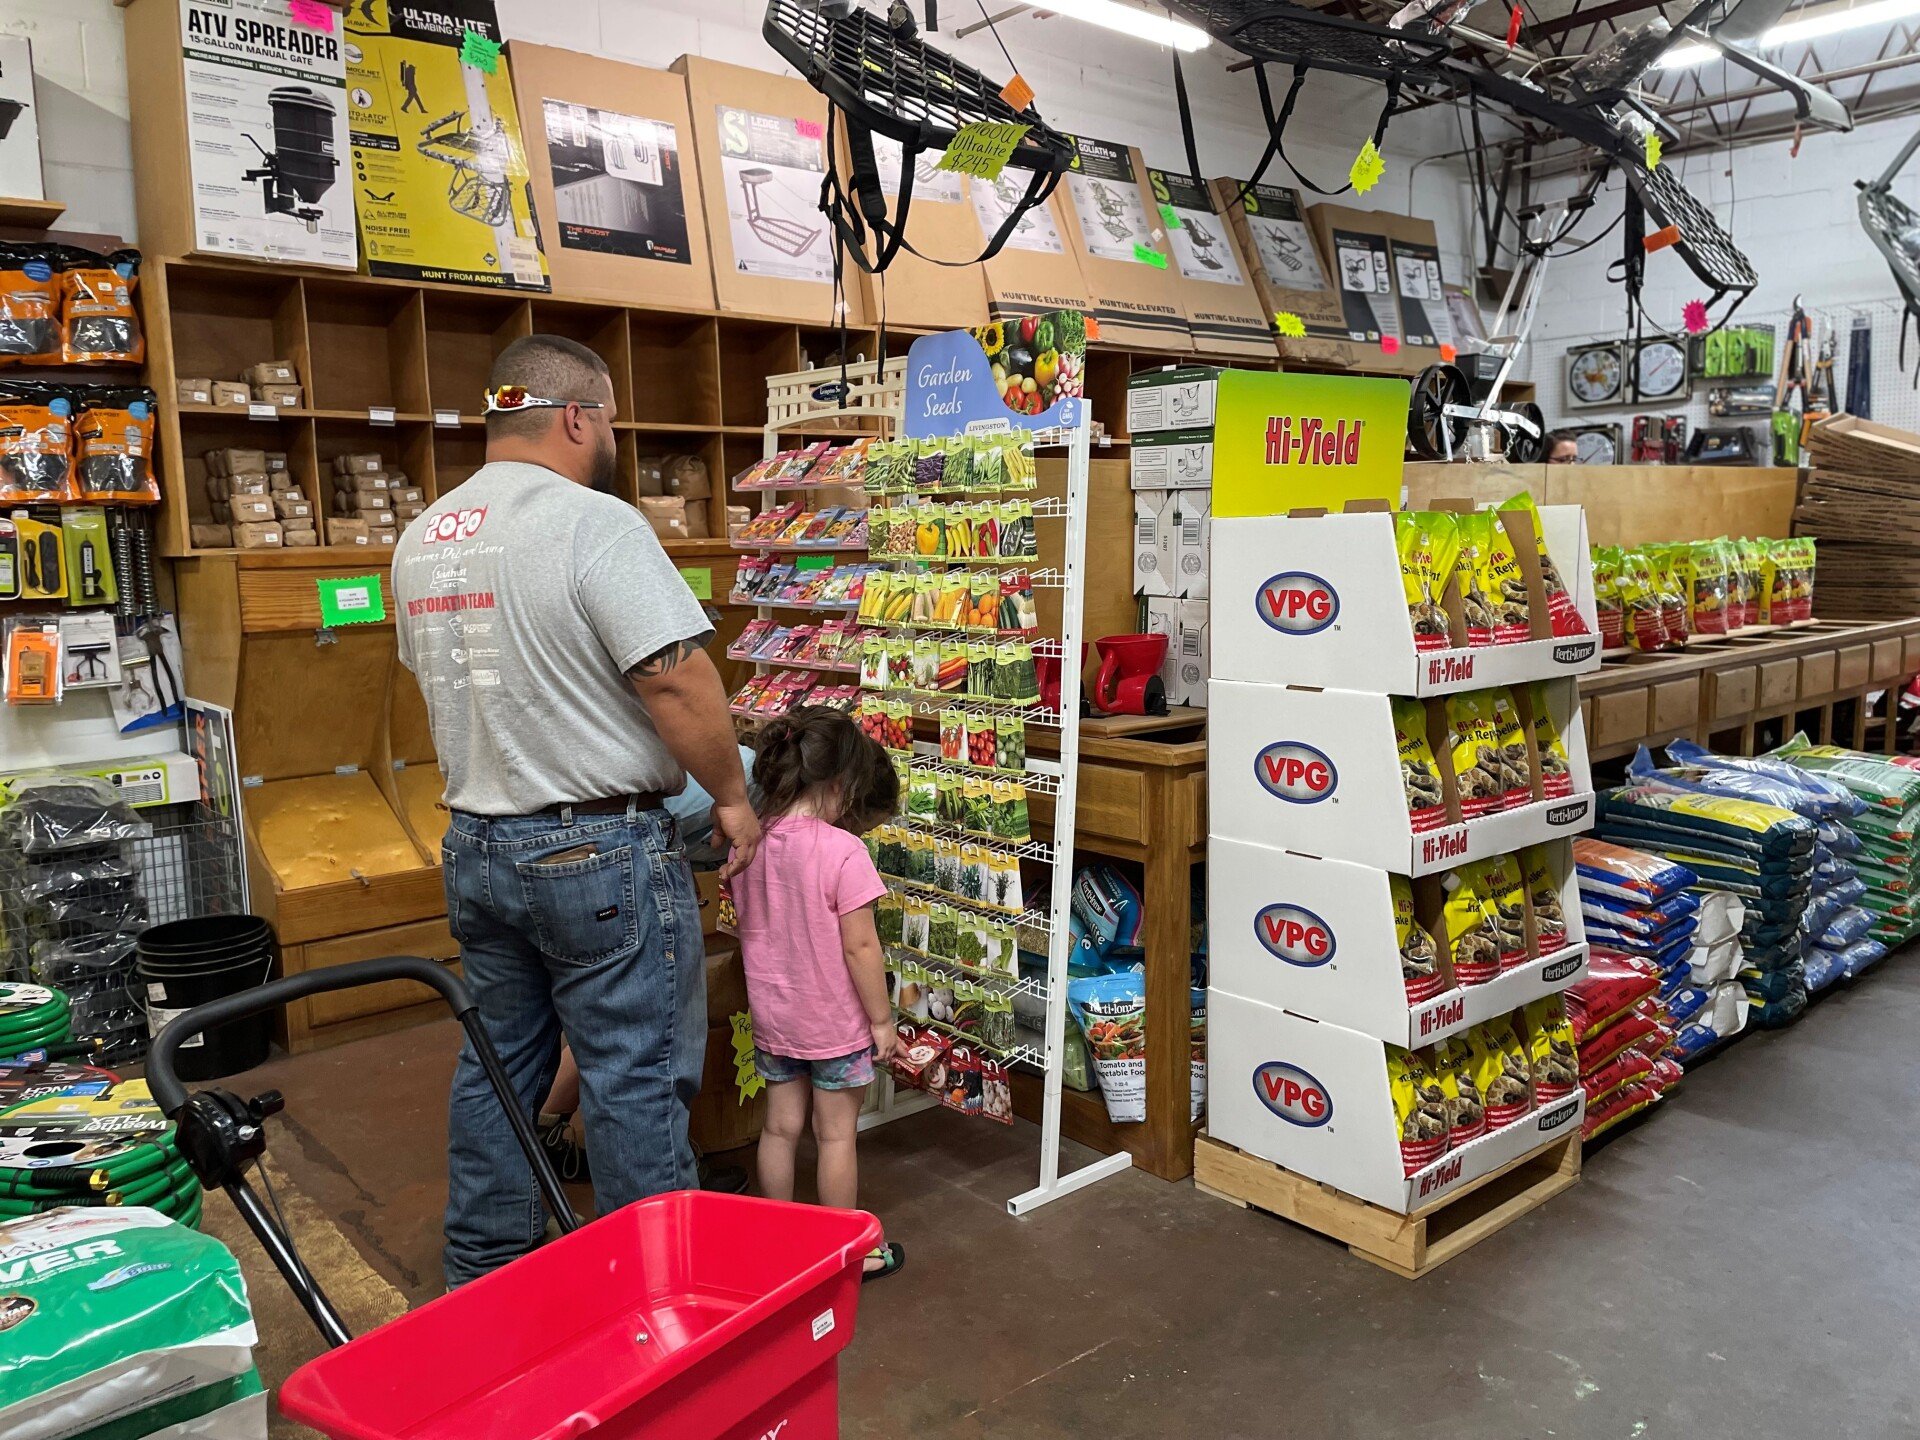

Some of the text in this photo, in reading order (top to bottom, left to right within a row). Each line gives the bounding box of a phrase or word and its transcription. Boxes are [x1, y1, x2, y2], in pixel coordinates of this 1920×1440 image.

[403, 8, 454, 26] ULTRA
[188, 8, 339, 61] ATV SPREADER
[405, 19, 453, 35] CLIMBING
[189, 34, 313, 66] 15-GALLON MANUAL GATE
[222, 54, 253, 68] COVERAGE
[259, 63, 283, 74] REDUCE
[284, 66, 298, 77] TIME
[303, 70, 319, 81] HUNT
[750, 115, 780, 130] LEDGE
[953, 136, 1007, 158] Ultralite
[1078, 143, 1108, 157] GOLIATH
[950, 154, 995, 174] $245
[1256, 186, 1284, 198] SENTRY
[365, 223, 388, 233] NOISE
[566, 225, 610, 237] THE ROOST
[421, 270, 447, 280] HUNT
[448, 272, 473, 282] FROM
[1002, 291, 1087, 308] HUNTING ELEVATED
[1098, 298, 1176, 314] HUNTING ELEVATED
[1193, 312, 1263, 326] HUNTING ELEVATED
[1310, 312, 1342, 323] ELEVATED
[917, 356, 972, 390] Garden
[923, 393, 963, 418] Seeds
[968, 422, 1007, 432] LIVINGSTON
[1265, 416, 1358, 465] Hi-Yield
[423, 504, 488, 544] 2020
[468, 592, 495, 609] TEAM
[1265, 588, 1331, 620] VPG
[1428, 656, 1473, 685] Hi-Yield
[1264, 755, 1329, 792] VPG
[1423, 831, 1468, 864] Hi-Yield
[1263, 914, 1328, 957] VPG
[1420, 998, 1464, 1036] Hi-Yield
[1100, 1060, 1143, 1069] Tomato and
[1261, 1072, 1324, 1118] VPG
[78, 1119, 168, 1132] Weather
[90, 1114, 145, 1126] FLEX
[1418, 1157, 1463, 1198] Hi-Yield
